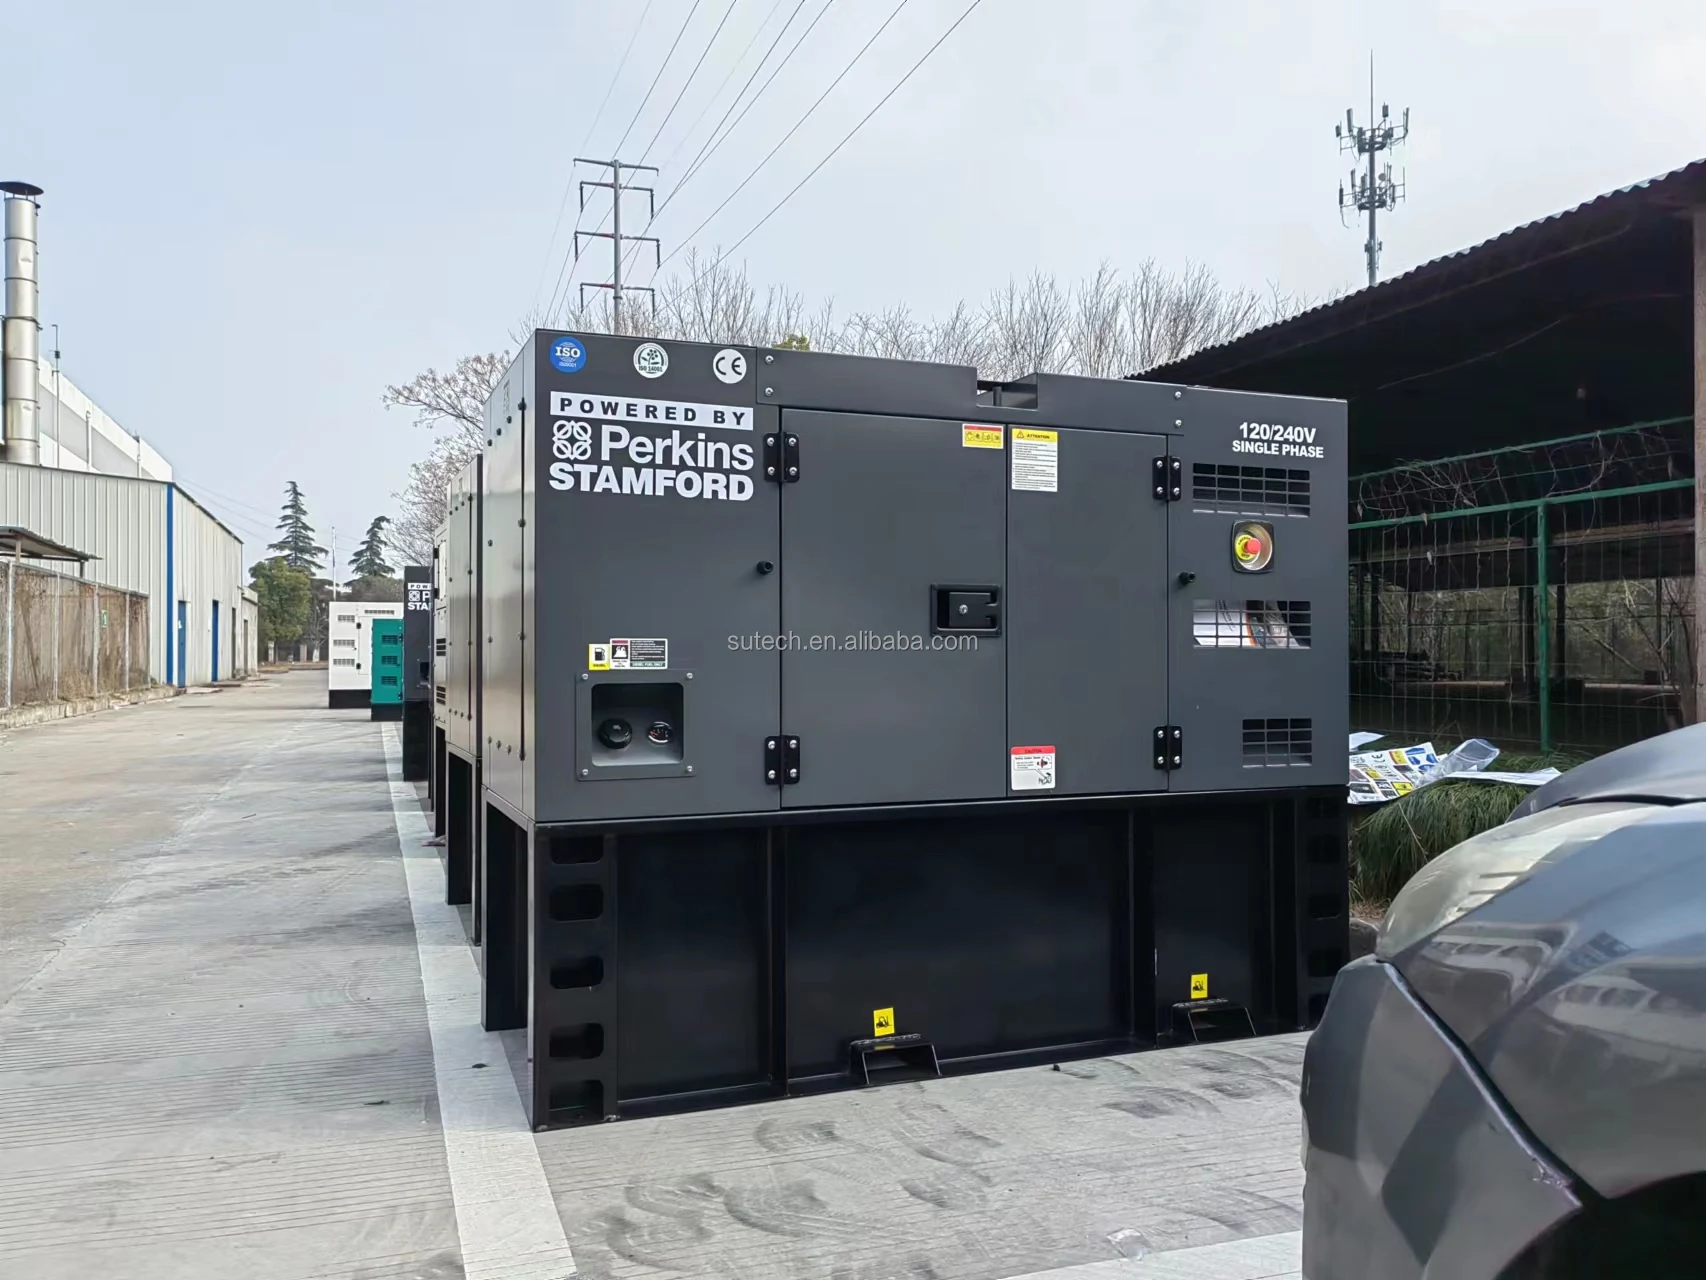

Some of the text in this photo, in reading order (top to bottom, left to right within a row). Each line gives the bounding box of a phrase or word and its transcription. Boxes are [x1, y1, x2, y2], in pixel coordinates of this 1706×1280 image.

[555, 346, 581, 358] ISO
[716, 356, 742, 376] CE
[559, 397, 745, 426] POWERED BY
[1240, 422, 1317, 444] 120/240V
[601, 424, 754, 471] Perkins
[1232, 440, 1324, 459] SINGLE PHASE
[549, 462, 754, 501] STAMFORD
